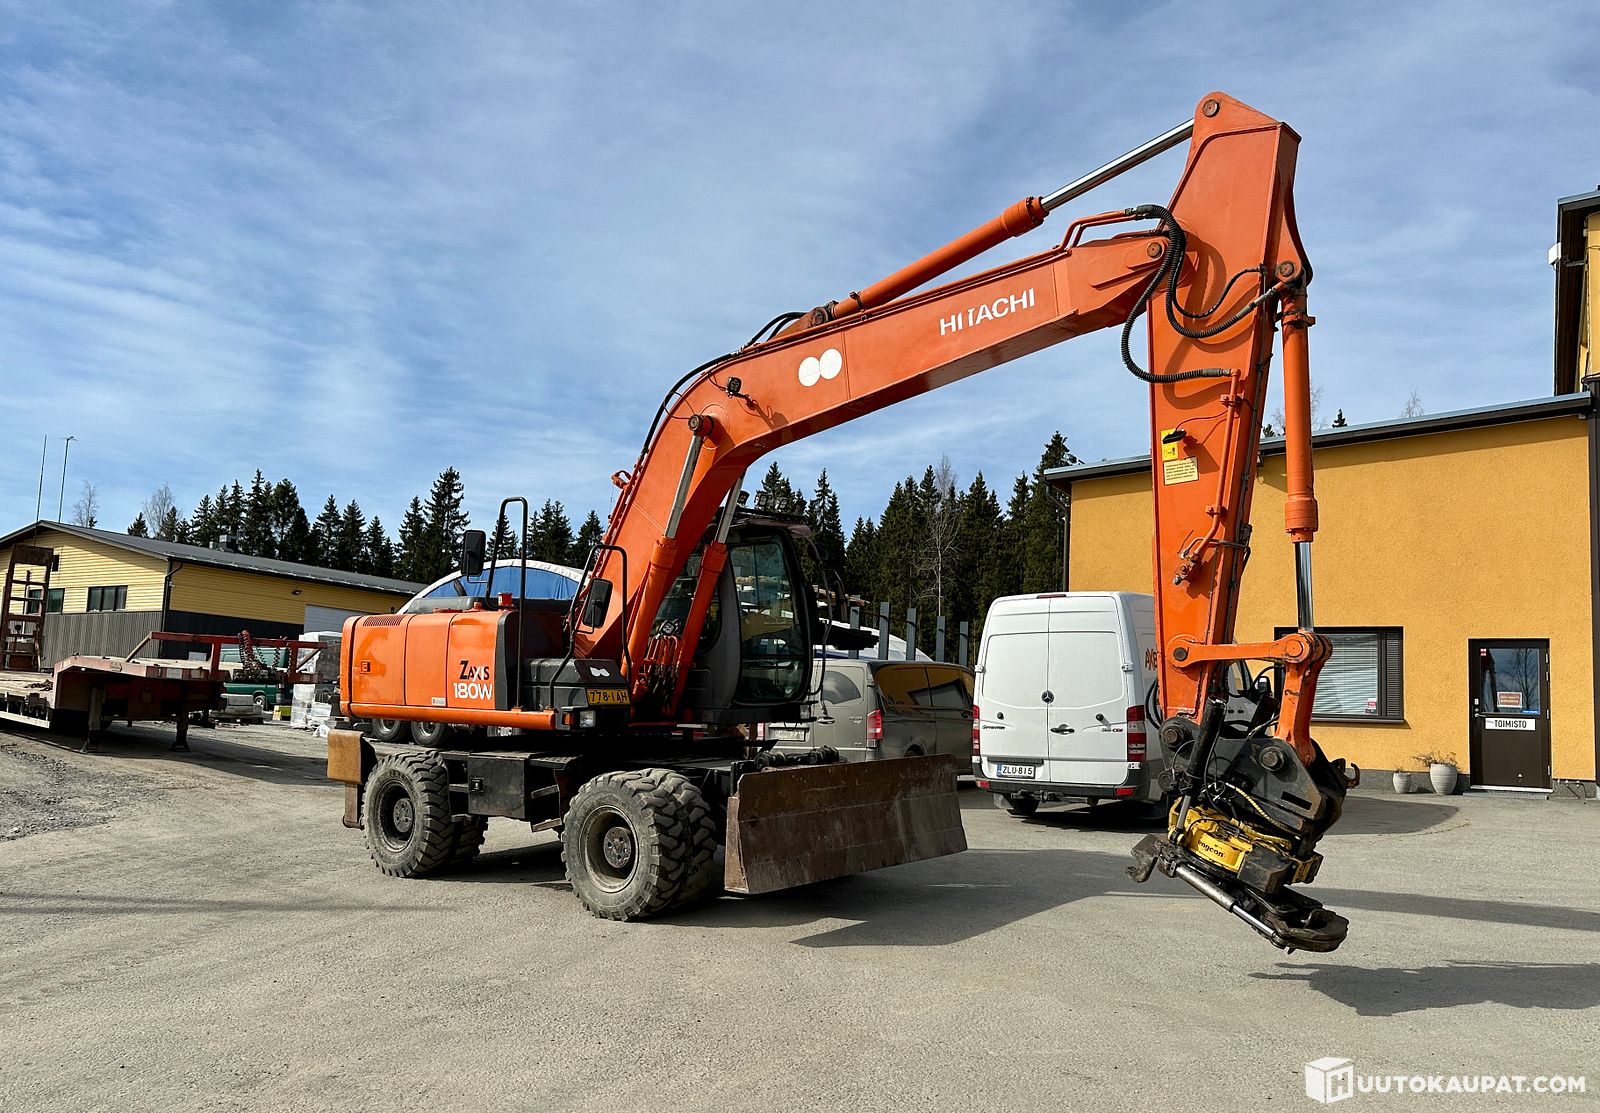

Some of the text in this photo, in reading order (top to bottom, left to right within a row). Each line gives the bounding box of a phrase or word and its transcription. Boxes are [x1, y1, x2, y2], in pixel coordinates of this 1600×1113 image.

[939, 288, 1036, 336] HITACHI
[453, 682, 493, 700] 180W
[1494, 719, 1527, 728] TOIMISTO
[1002, 765, 1033, 775] ZLU-815
[1197, 839, 1225, 858] engcon
